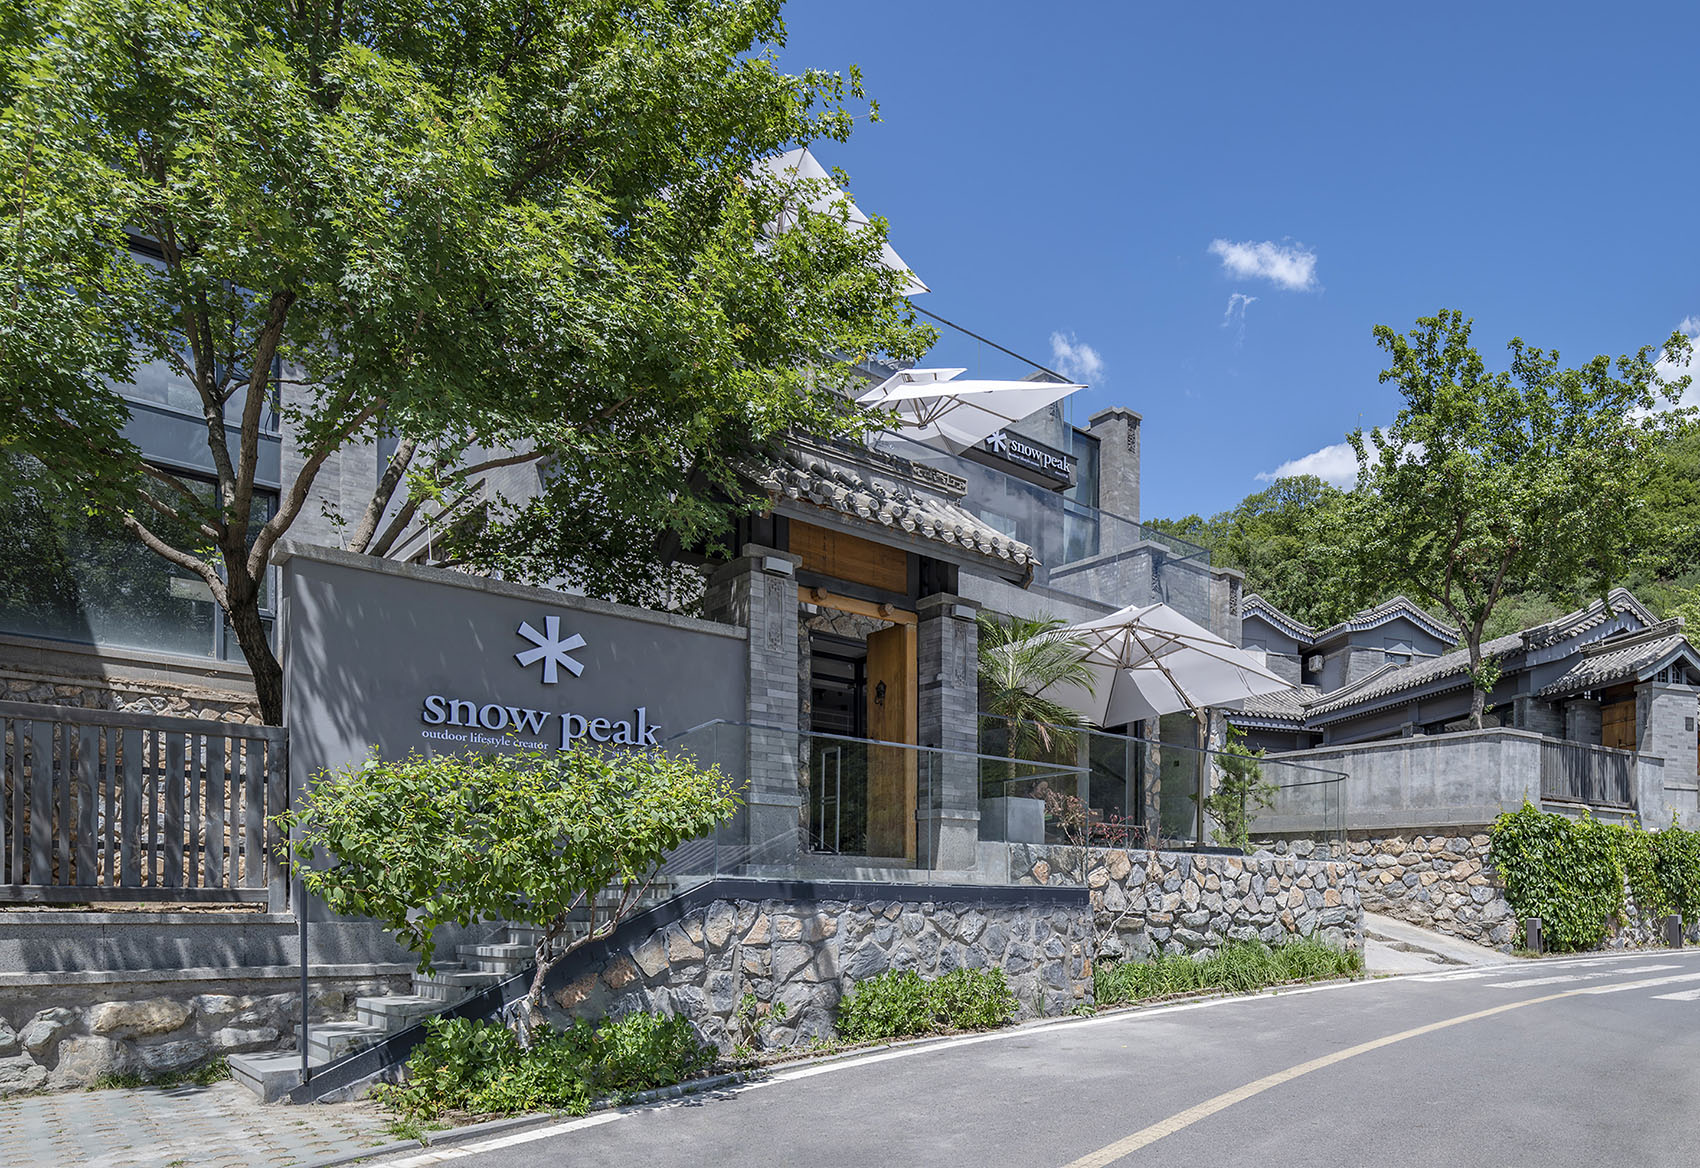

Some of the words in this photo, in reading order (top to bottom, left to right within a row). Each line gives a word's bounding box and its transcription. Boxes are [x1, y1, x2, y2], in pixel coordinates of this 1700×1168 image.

[1011, 440, 1042, 460] snow
[1044, 454, 1071, 473] peak
[422, 695, 551, 735] snow
[559, 707, 662, 752] peak
[422, 729, 467, 742] outdoor
[470, 733, 511, 748] lifestyle
[513, 739, 549, 750] creator
